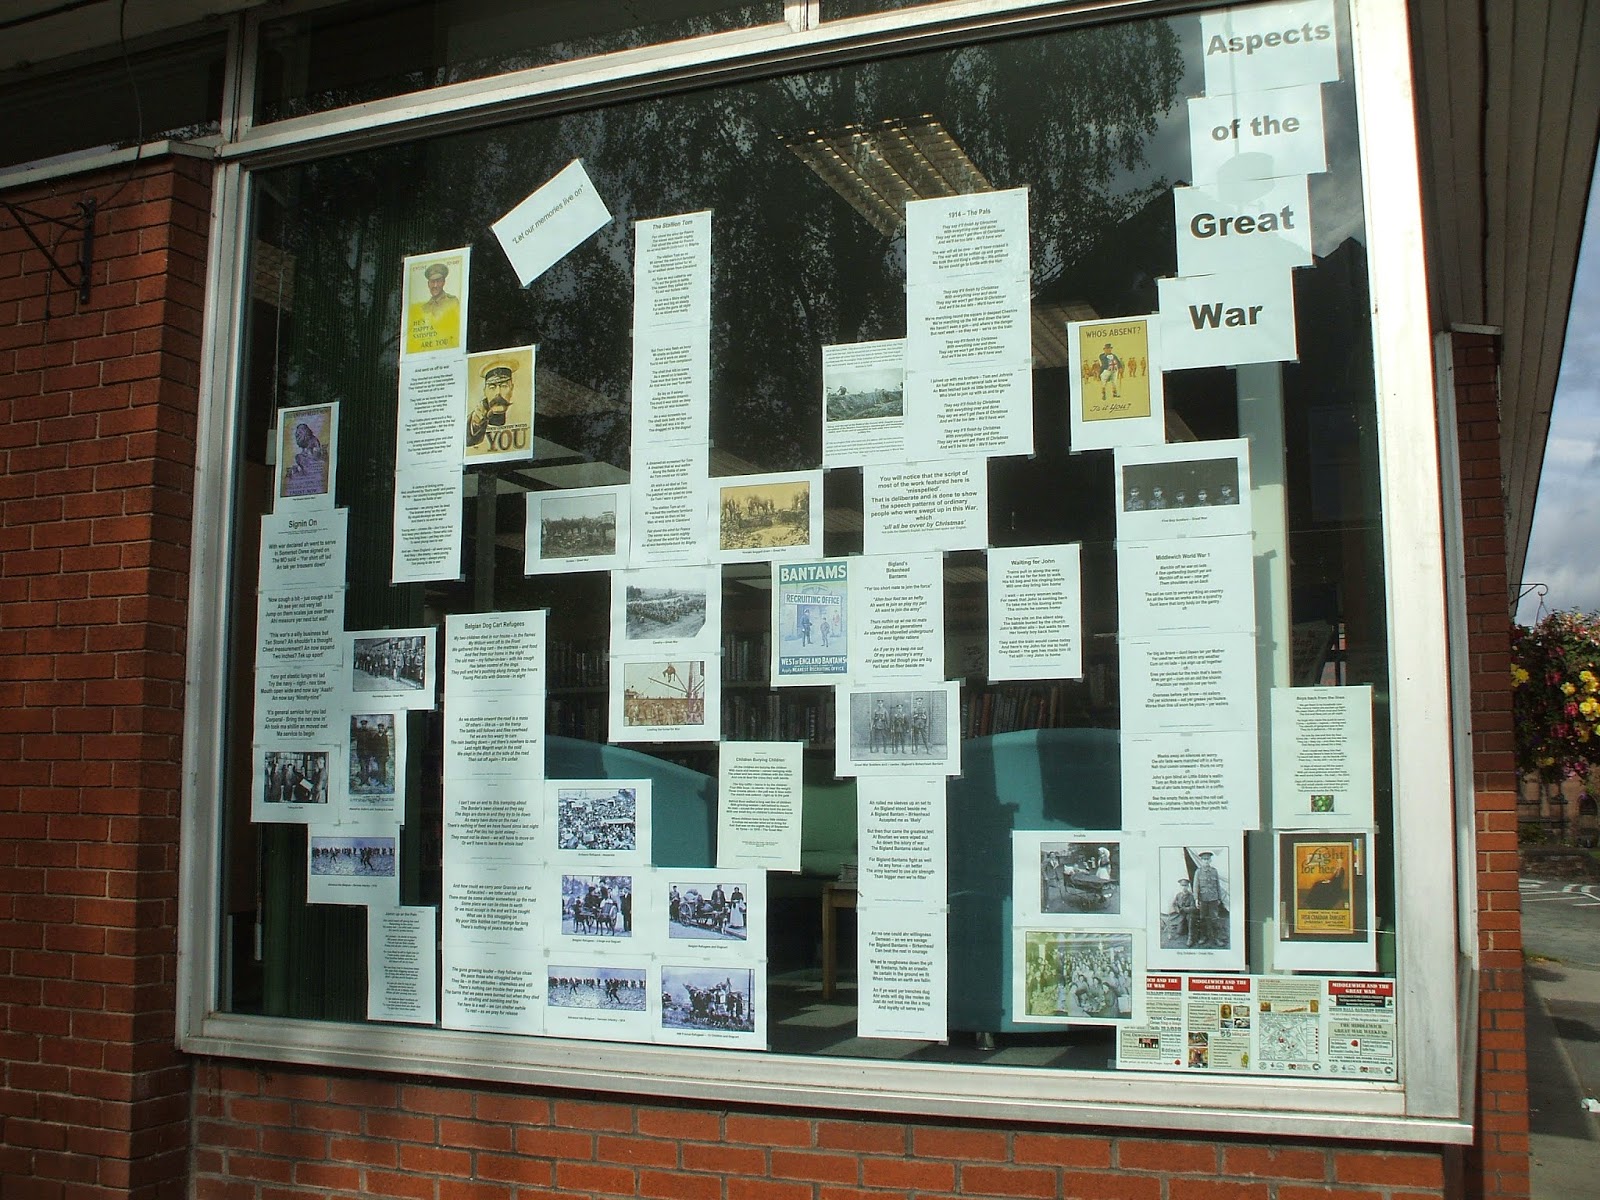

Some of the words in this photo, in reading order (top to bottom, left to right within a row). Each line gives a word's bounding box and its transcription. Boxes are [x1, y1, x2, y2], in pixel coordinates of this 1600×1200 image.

[1207, 22, 1330, 55] Aspects
[1212, 118, 1241, 141] of
[1250, 115, 1300, 136] the
[525, 225, 534, 236] our
[535, 203, 563, 228] memories
[563, 195, 574, 207] live
[1190, 205, 1294, 238] Great
[1188, 302, 1263, 330] War
[1086, 329, 1107, 338] WHO'S
[1108, 327, 1141, 337] ABSENT?
[486, 428, 528, 451] YOU
[289, 520, 307, 529] Signin
[781, 564, 847, 582] BANTAMS
[786, 594, 821, 604] RECRUITING
[822, 596, 840, 604] OFFICE
[1305, 847, 1344, 865] fight
[1301, 861, 1314, 874] for
